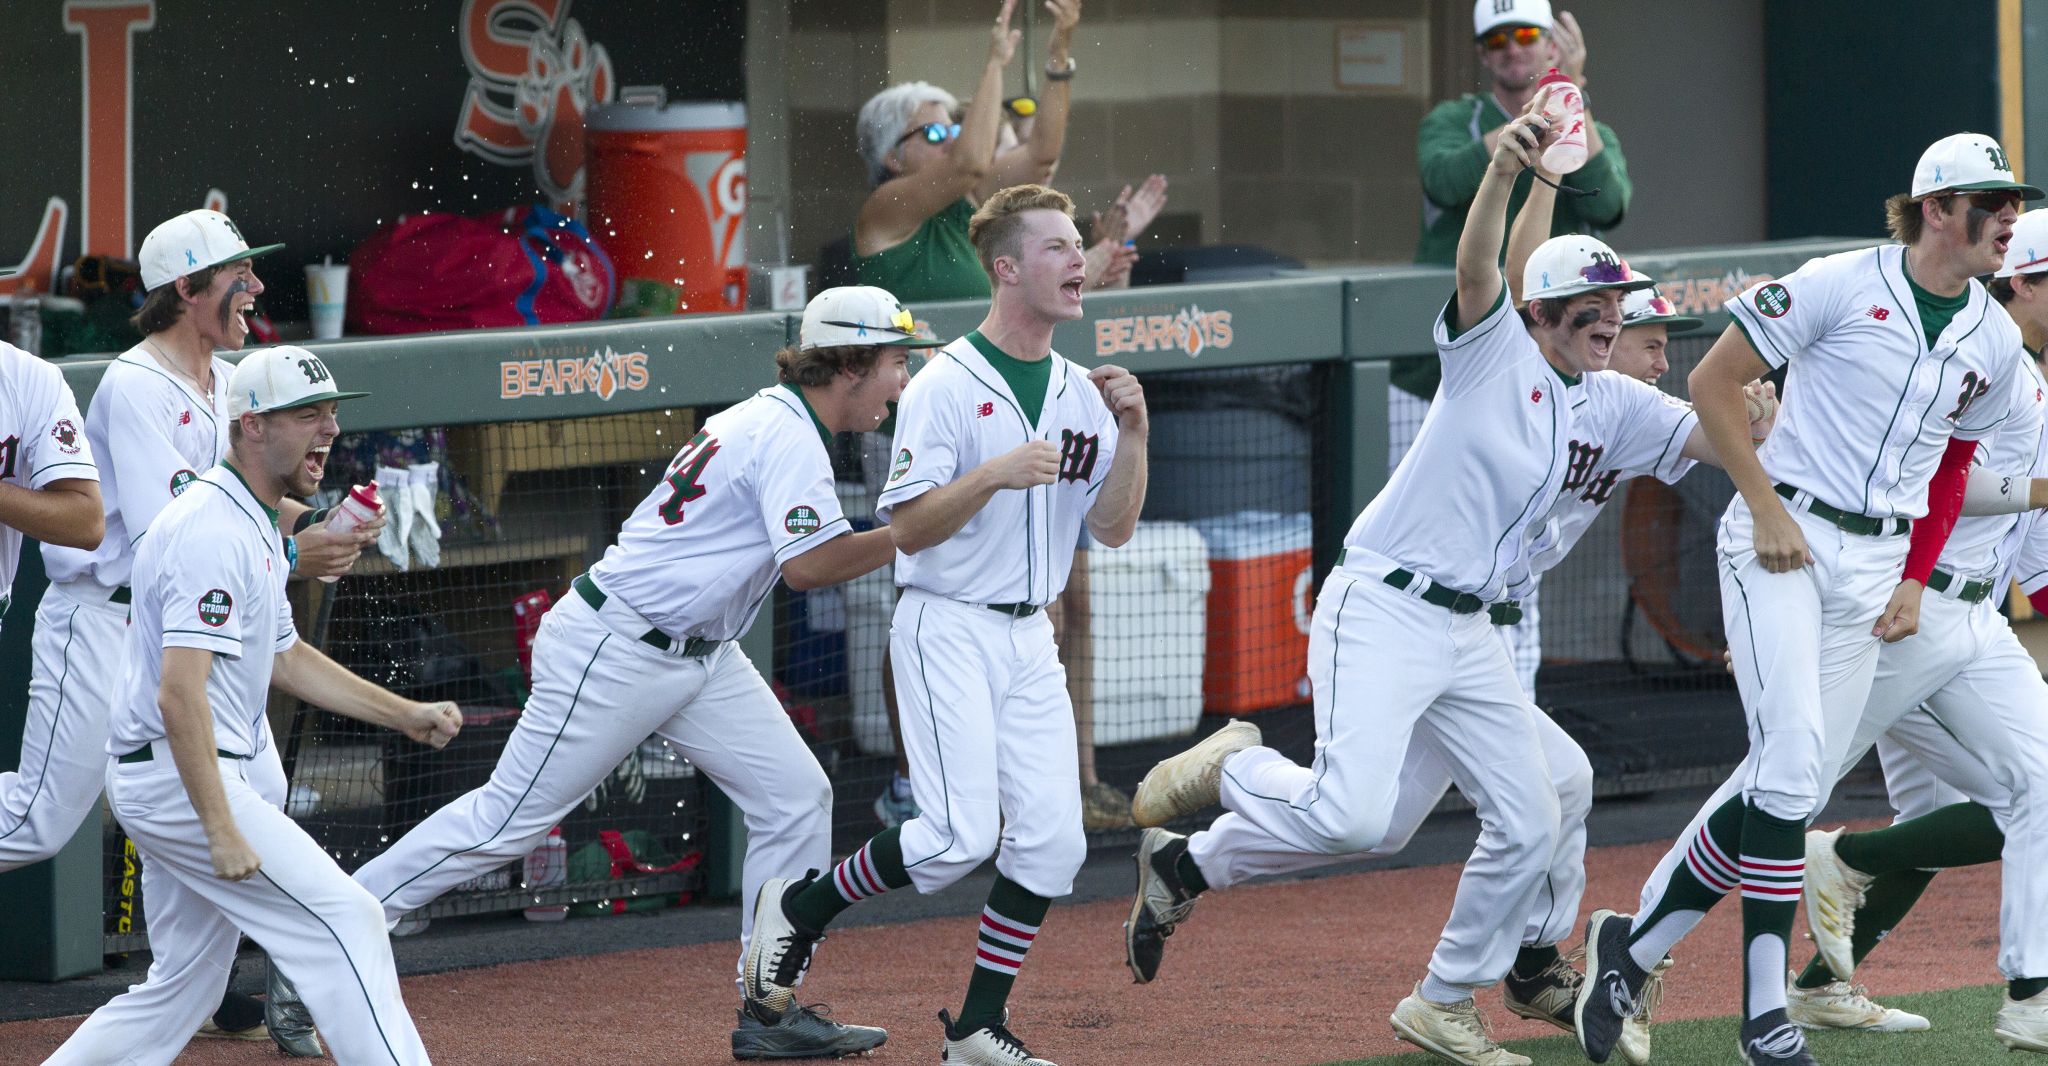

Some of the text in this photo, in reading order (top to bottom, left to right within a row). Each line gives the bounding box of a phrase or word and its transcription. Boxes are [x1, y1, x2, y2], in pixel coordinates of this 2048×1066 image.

[1760, 287, 1785, 315] STRONG
[787, 518, 819, 527] STRONG
[200, 602, 229, 615] STRONG
